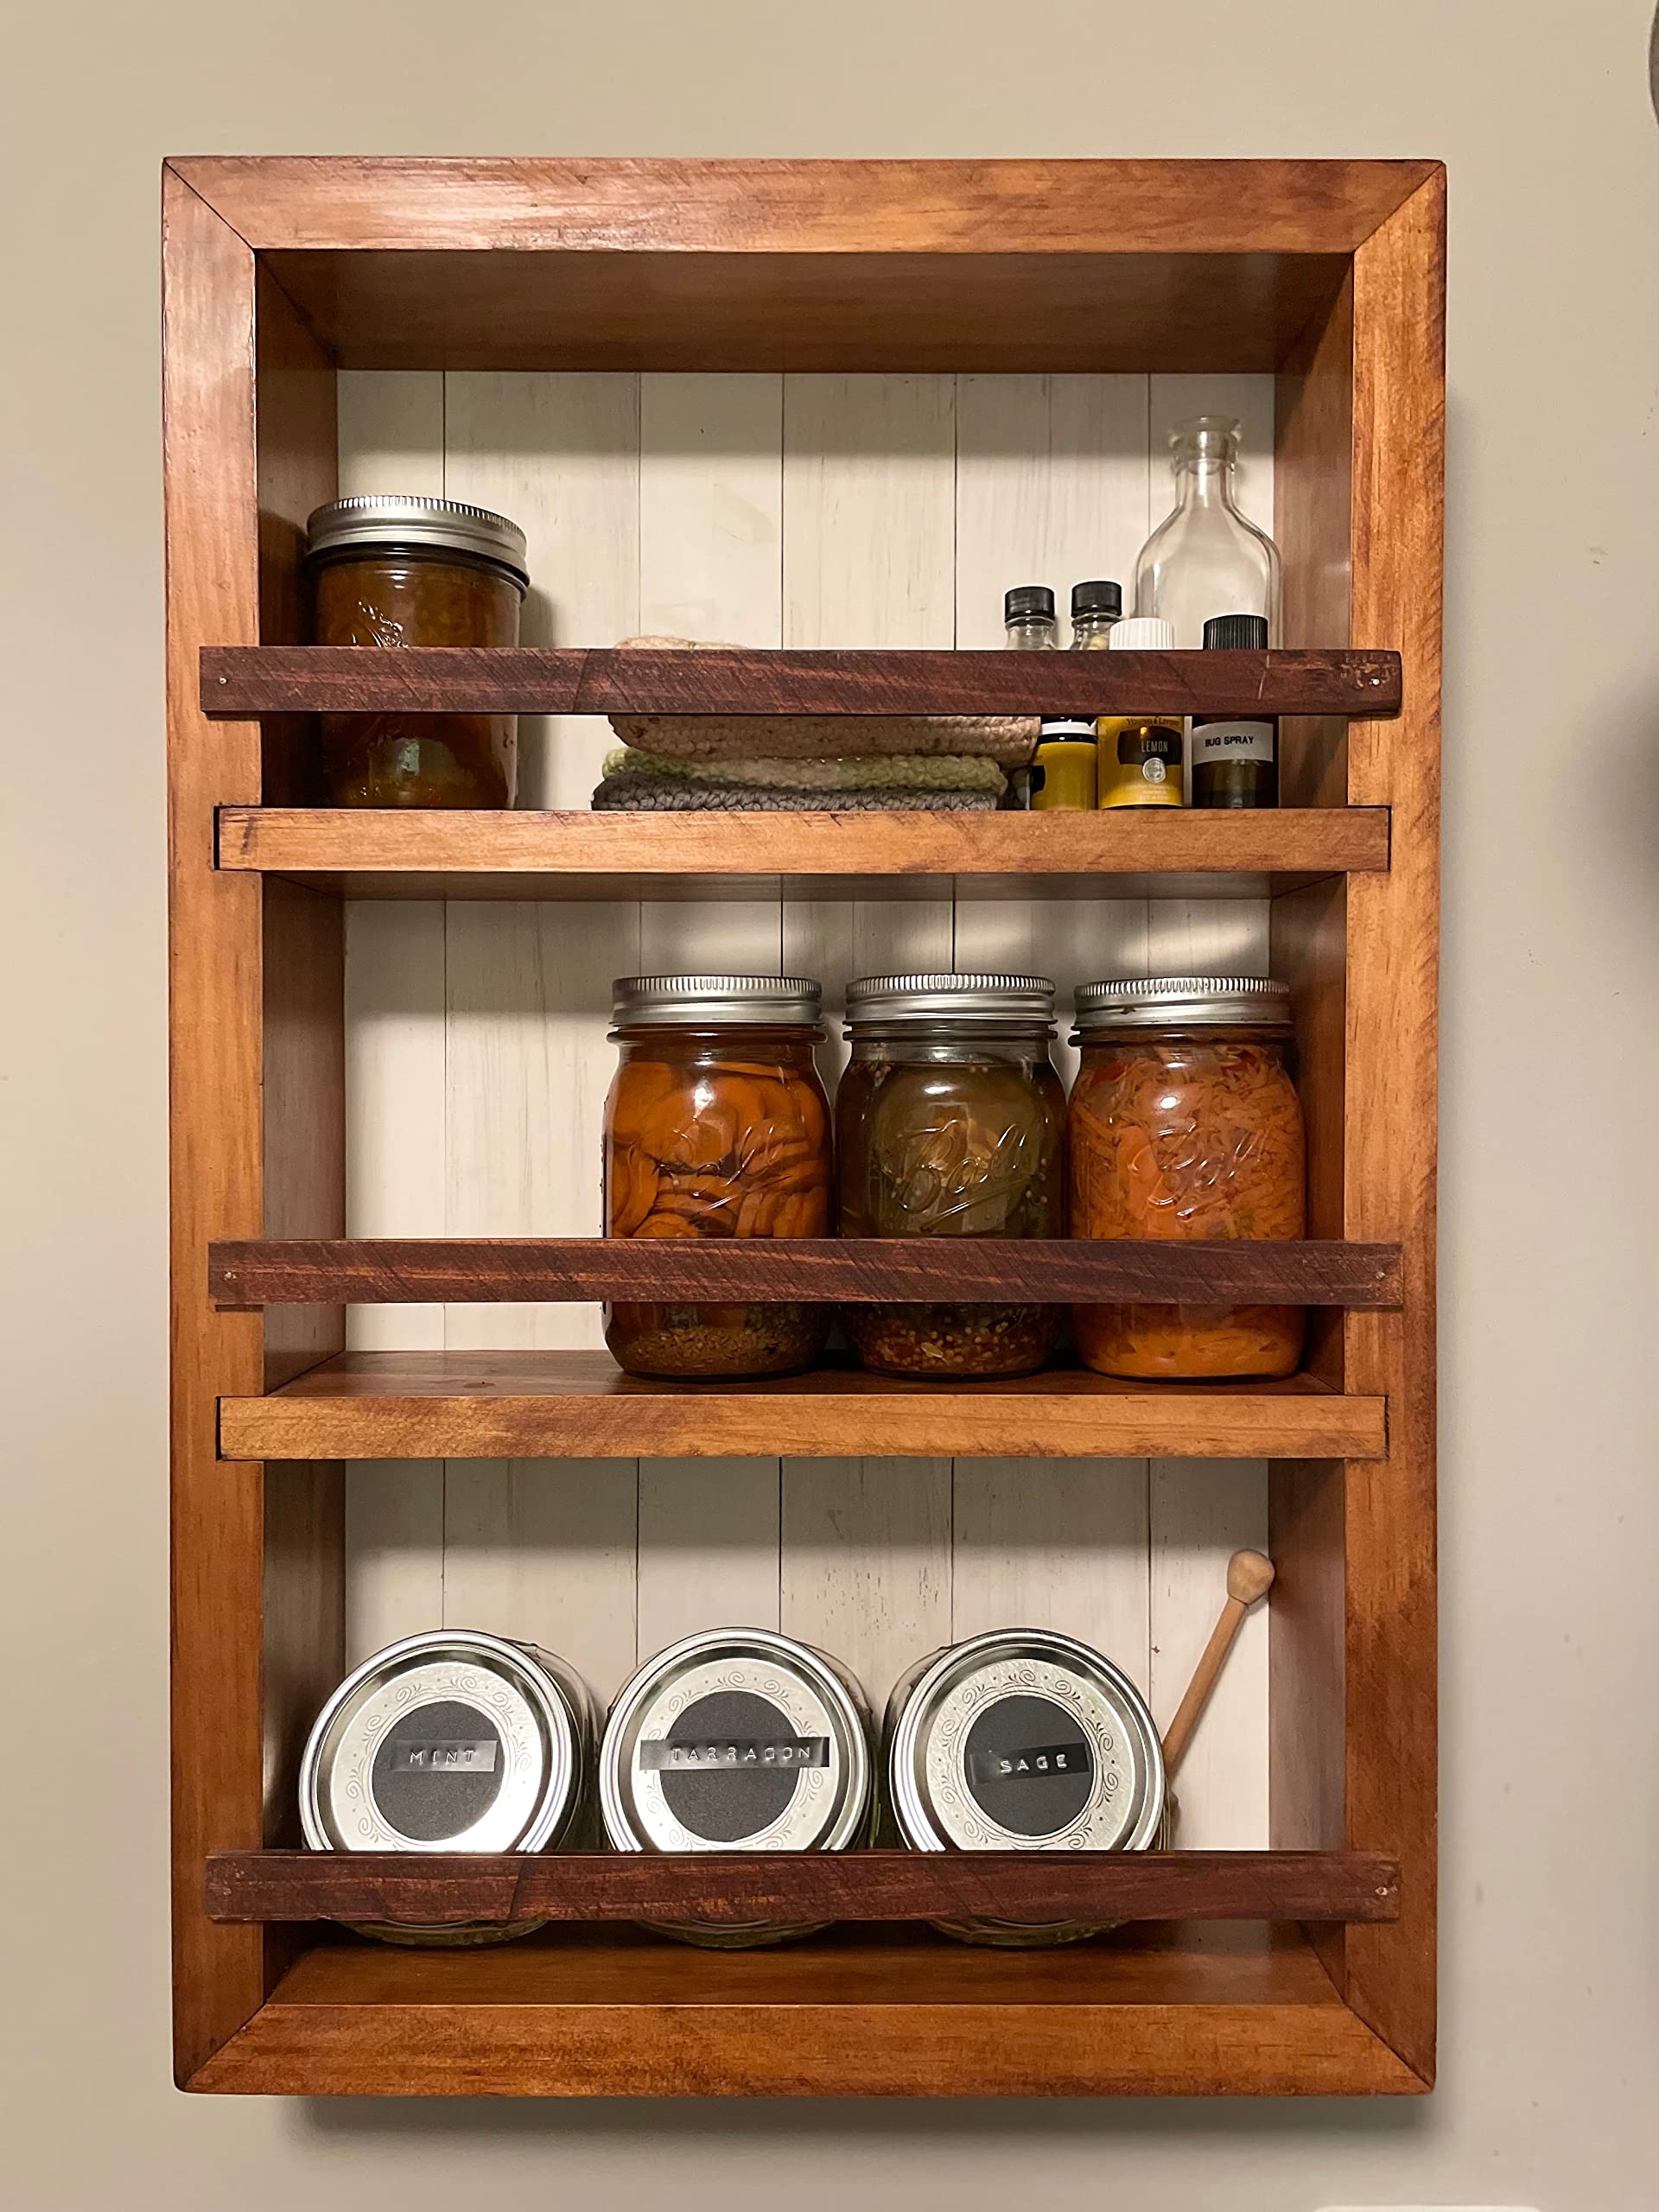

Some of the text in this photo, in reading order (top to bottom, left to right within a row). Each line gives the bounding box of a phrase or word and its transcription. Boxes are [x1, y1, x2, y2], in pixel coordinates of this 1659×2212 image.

[1141, 740, 1168, 753] LEMON
[1205, 735, 1254, 747] BUG SPRAY
[878, 1118, 1030, 1217] Ball
[410, 1749, 475, 1764] MINT
[671, 1746, 810, 1761] TARRAGON
[1000, 1753, 1067, 1774] SAGE
